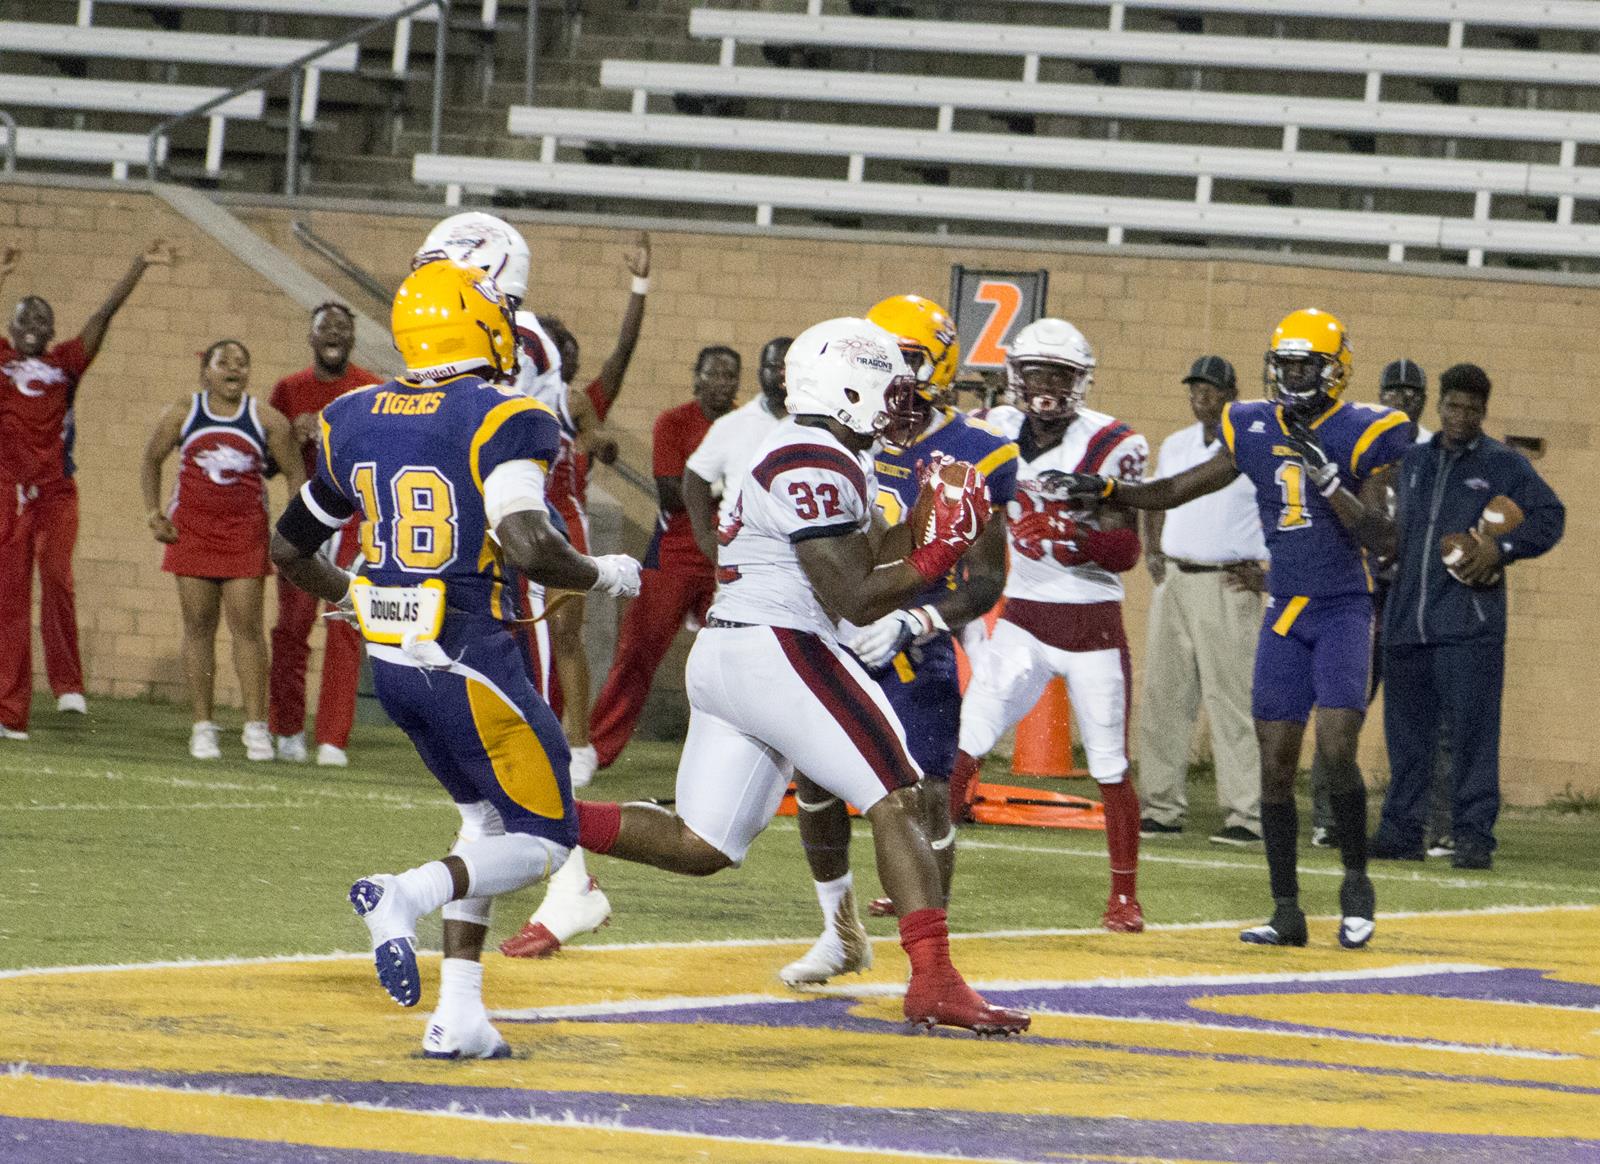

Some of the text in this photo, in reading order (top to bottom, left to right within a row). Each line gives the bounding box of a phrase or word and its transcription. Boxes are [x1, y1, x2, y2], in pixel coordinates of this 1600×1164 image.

[964, 281, 1023, 367] 2
[413, 365, 457, 382] Riddell
[371, 391, 446, 415] TIGERS
[788, 481, 845, 520] 32
[1275, 461, 1312, 531] 1
[350, 462, 458, 574] 18
[370, 599, 419, 622] DOUGLAS
